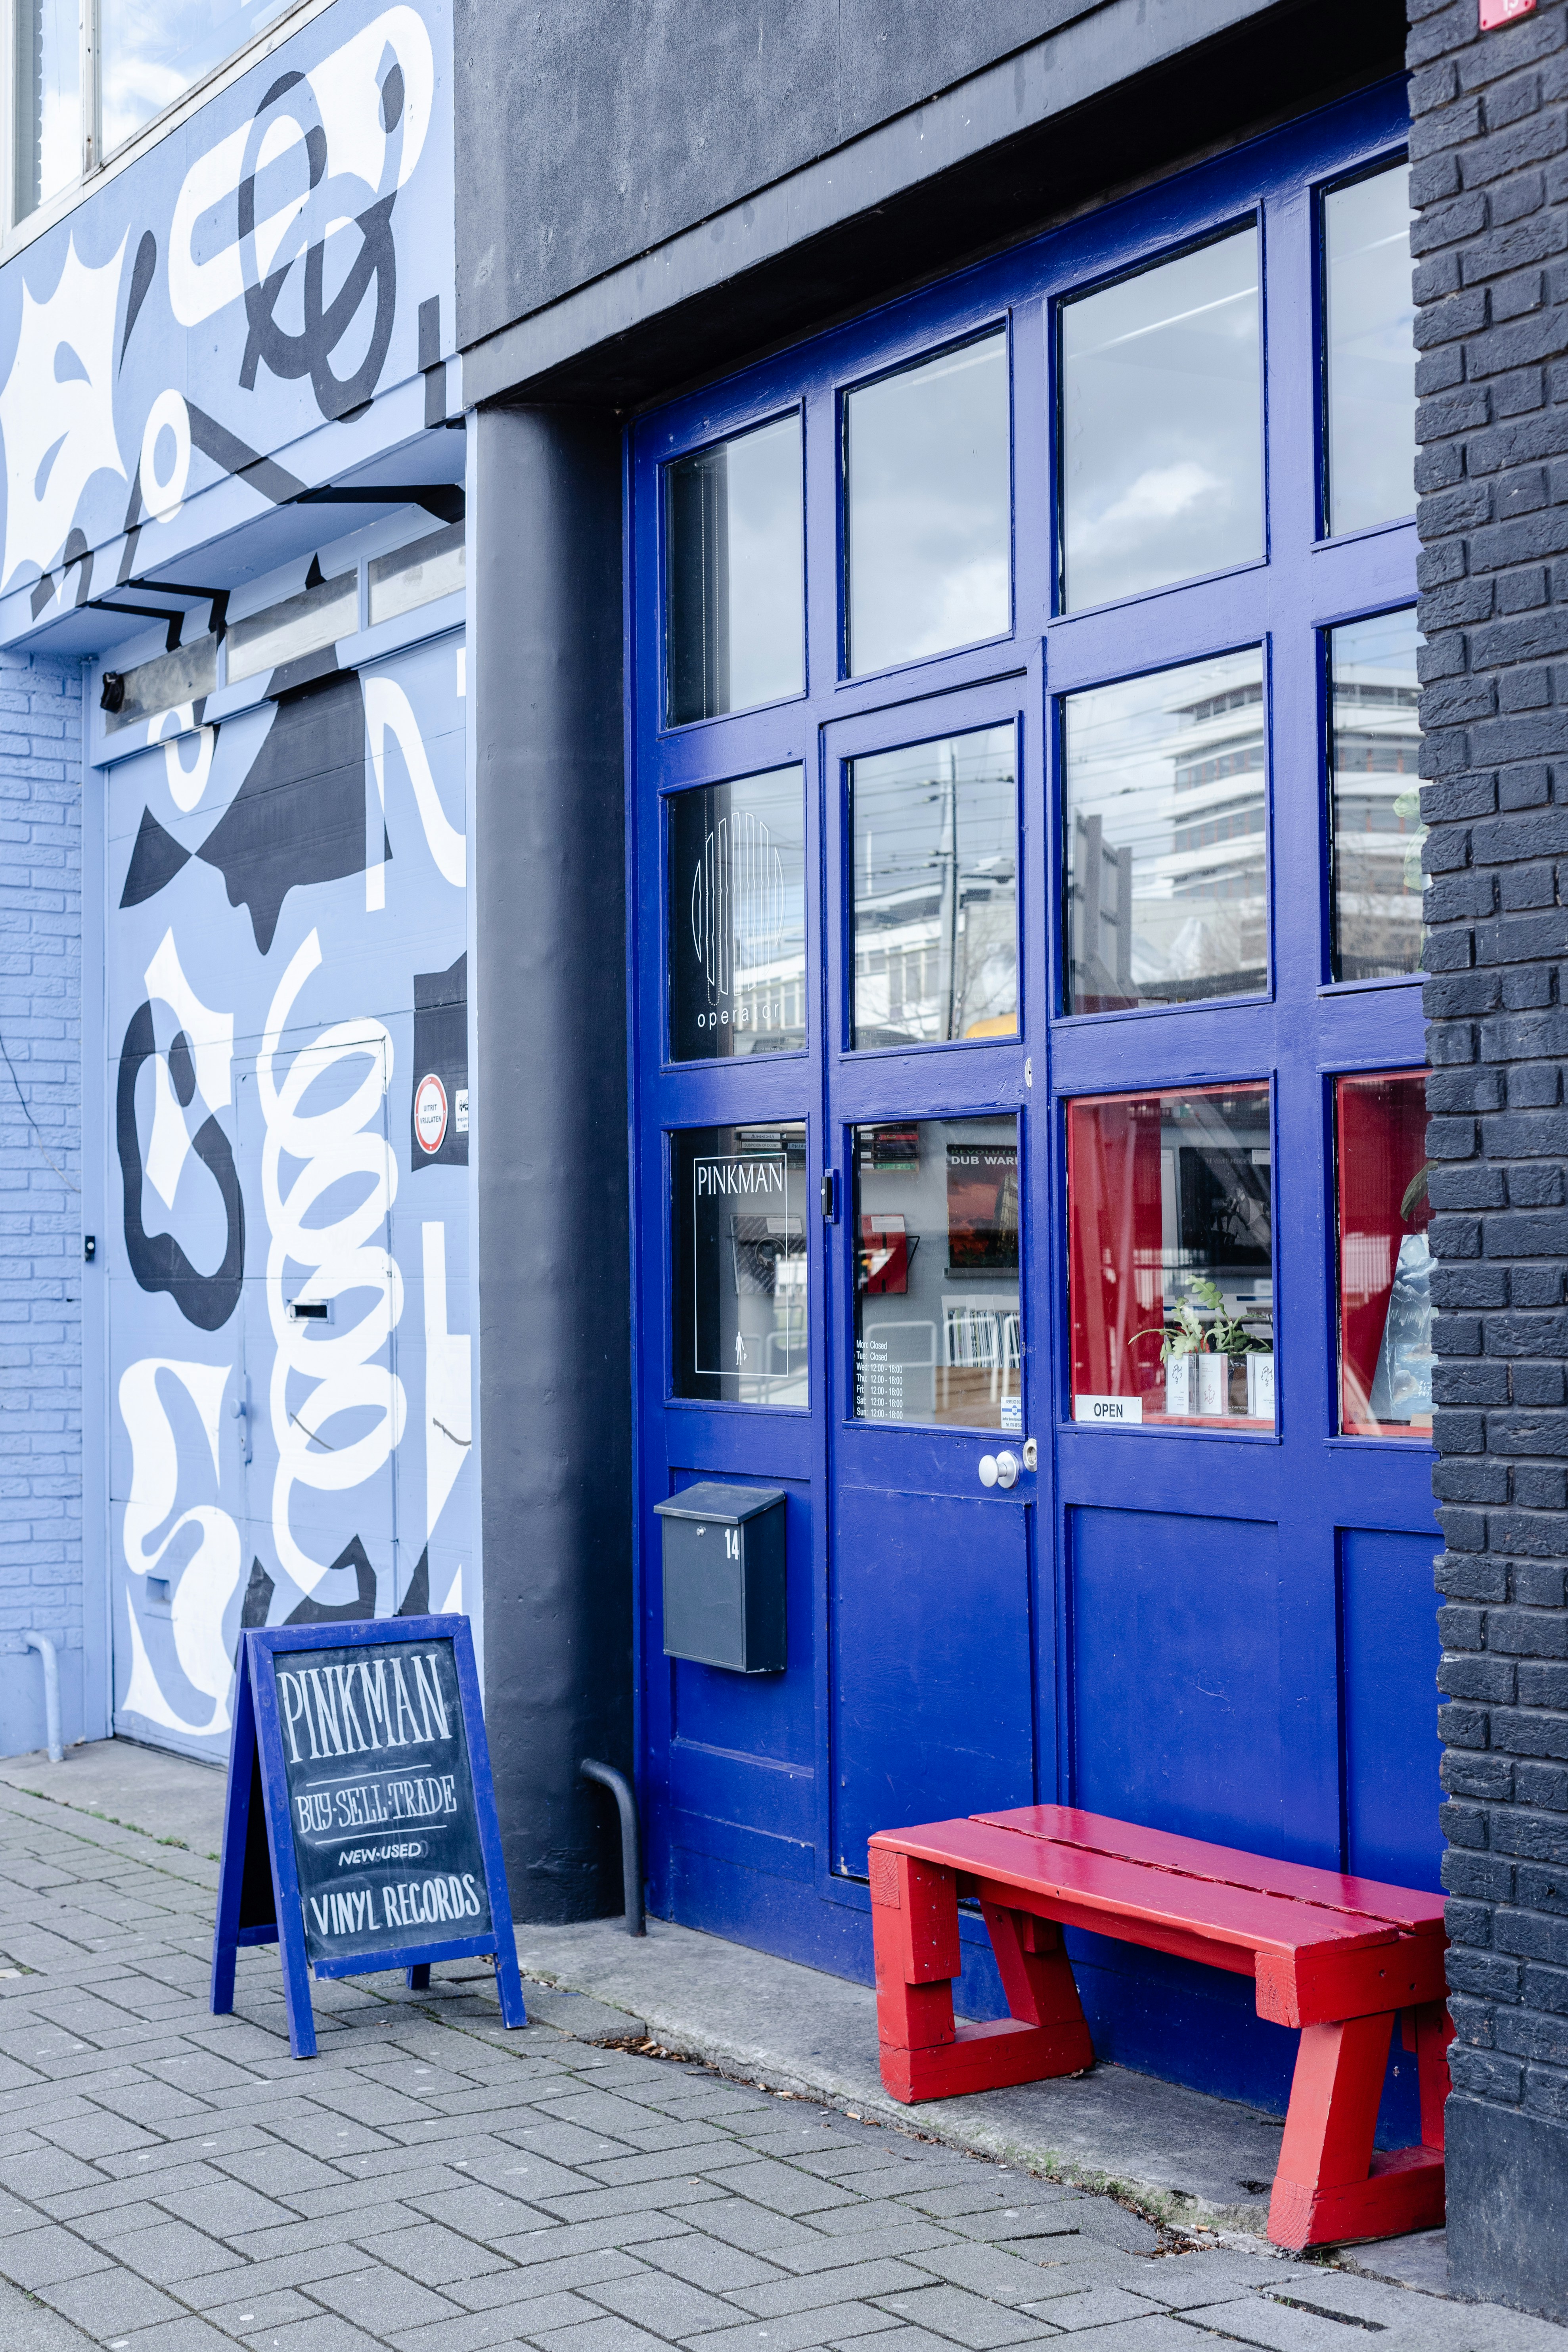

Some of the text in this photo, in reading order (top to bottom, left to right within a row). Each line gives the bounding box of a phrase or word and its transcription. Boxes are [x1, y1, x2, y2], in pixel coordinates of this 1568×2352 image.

[697, 1004, 779, 1030] operator
[420, 1115, 442, 1124] VRIJLATEN
[952, 1156, 979, 1165] DUB
[698, 1163, 782, 1195] PINKMAN
[856, 1340, 887, 1350] Mon: Closed
[856, 1351, 887, 1361] Tue: Closed
[856, 1362, 869, 1371] Wed:
[871, 1364, 884, 1372] 12:00
[889, 1365, 903, 1373] 18:00
[856, 1373, 867, 1382] Thu:
[871, 1375, 884, 1383] 12:00
[889, 1376, 903, 1385] 18:00
[871, 1387, 884, 1395] 12:00
[889, 1387, 903, 1396] 18:00
[856, 1396, 866, 1404] Sat:
[871, 1398, 884, 1406] 12:00
[889, 1399, 903, 1408] 18:00
[856, 1407, 868, 1416] Sun:
[871, 1409, 884, 1417] 12:00
[889, 1410, 903, 1419] 18:00
[1094, 1403, 1123, 1417] OPEN
[725, 1529, 739, 1560] 14
[276, 1654, 453, 1764] PINKMAN
[310, 1874, 481, 1935] VINYL RECORDS
